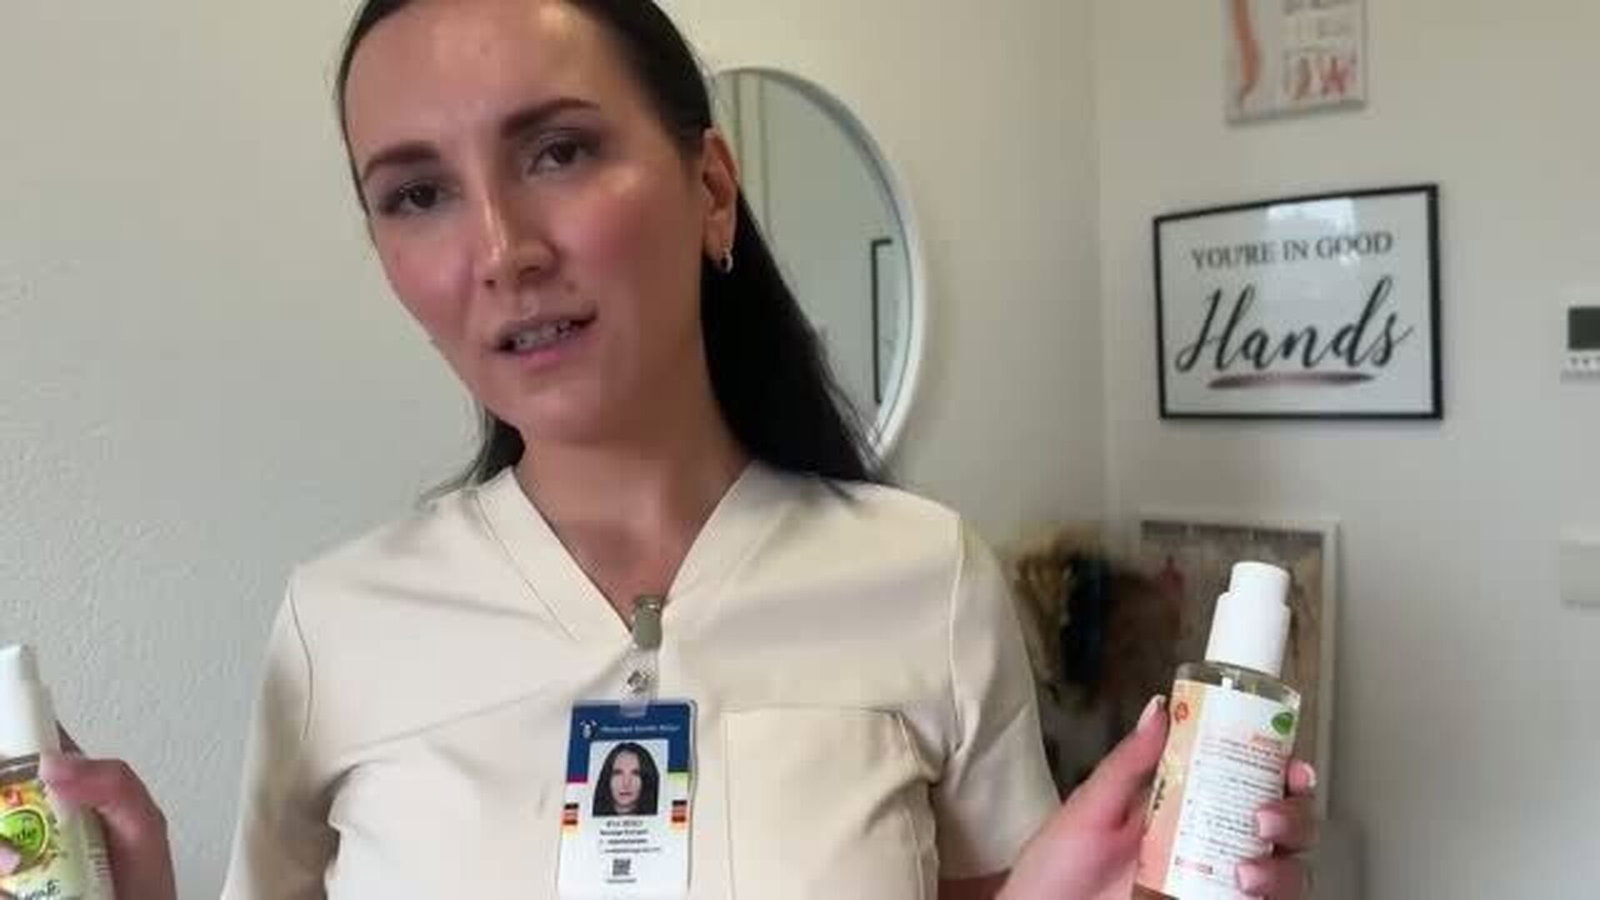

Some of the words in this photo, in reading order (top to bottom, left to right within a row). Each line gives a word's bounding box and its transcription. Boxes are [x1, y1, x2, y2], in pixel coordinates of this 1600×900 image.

[1191, 241, 1276, 270] YOU'RE
[1282, 239, 1308, 261] IN
[1316, 231, 1393, 260] GOOD
[1175, 276, 1414, 372] Hands
